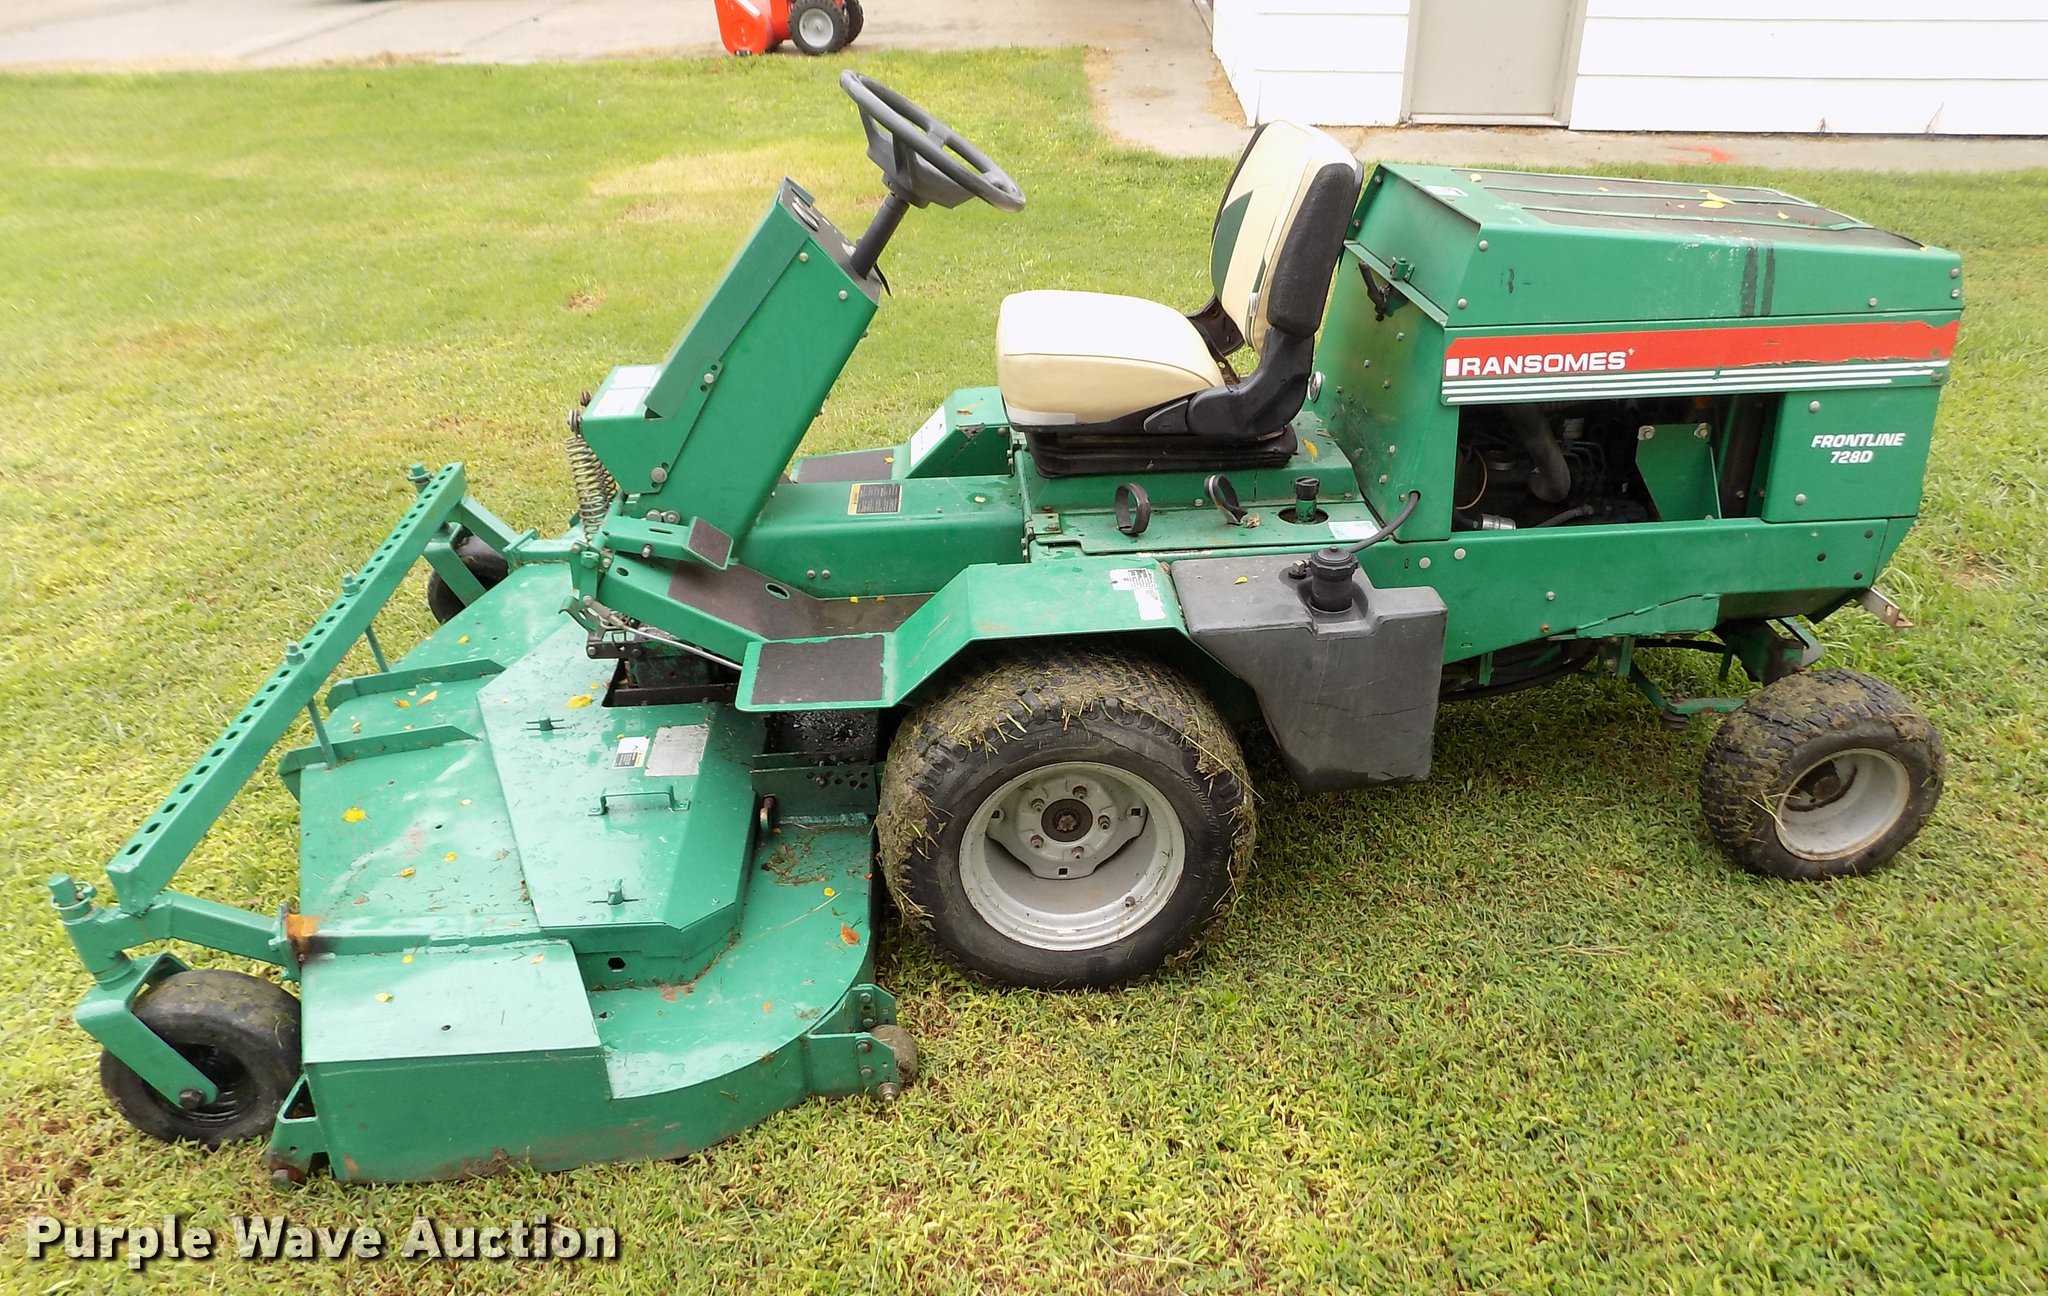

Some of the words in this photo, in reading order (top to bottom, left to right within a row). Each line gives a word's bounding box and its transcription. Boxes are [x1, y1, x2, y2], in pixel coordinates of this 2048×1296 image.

[1461, 351, 1627, 376] RANSOMES
[1810, 432, 1906, 448] FRONTLINE
[1829, 450, 1874, 464] 728D
